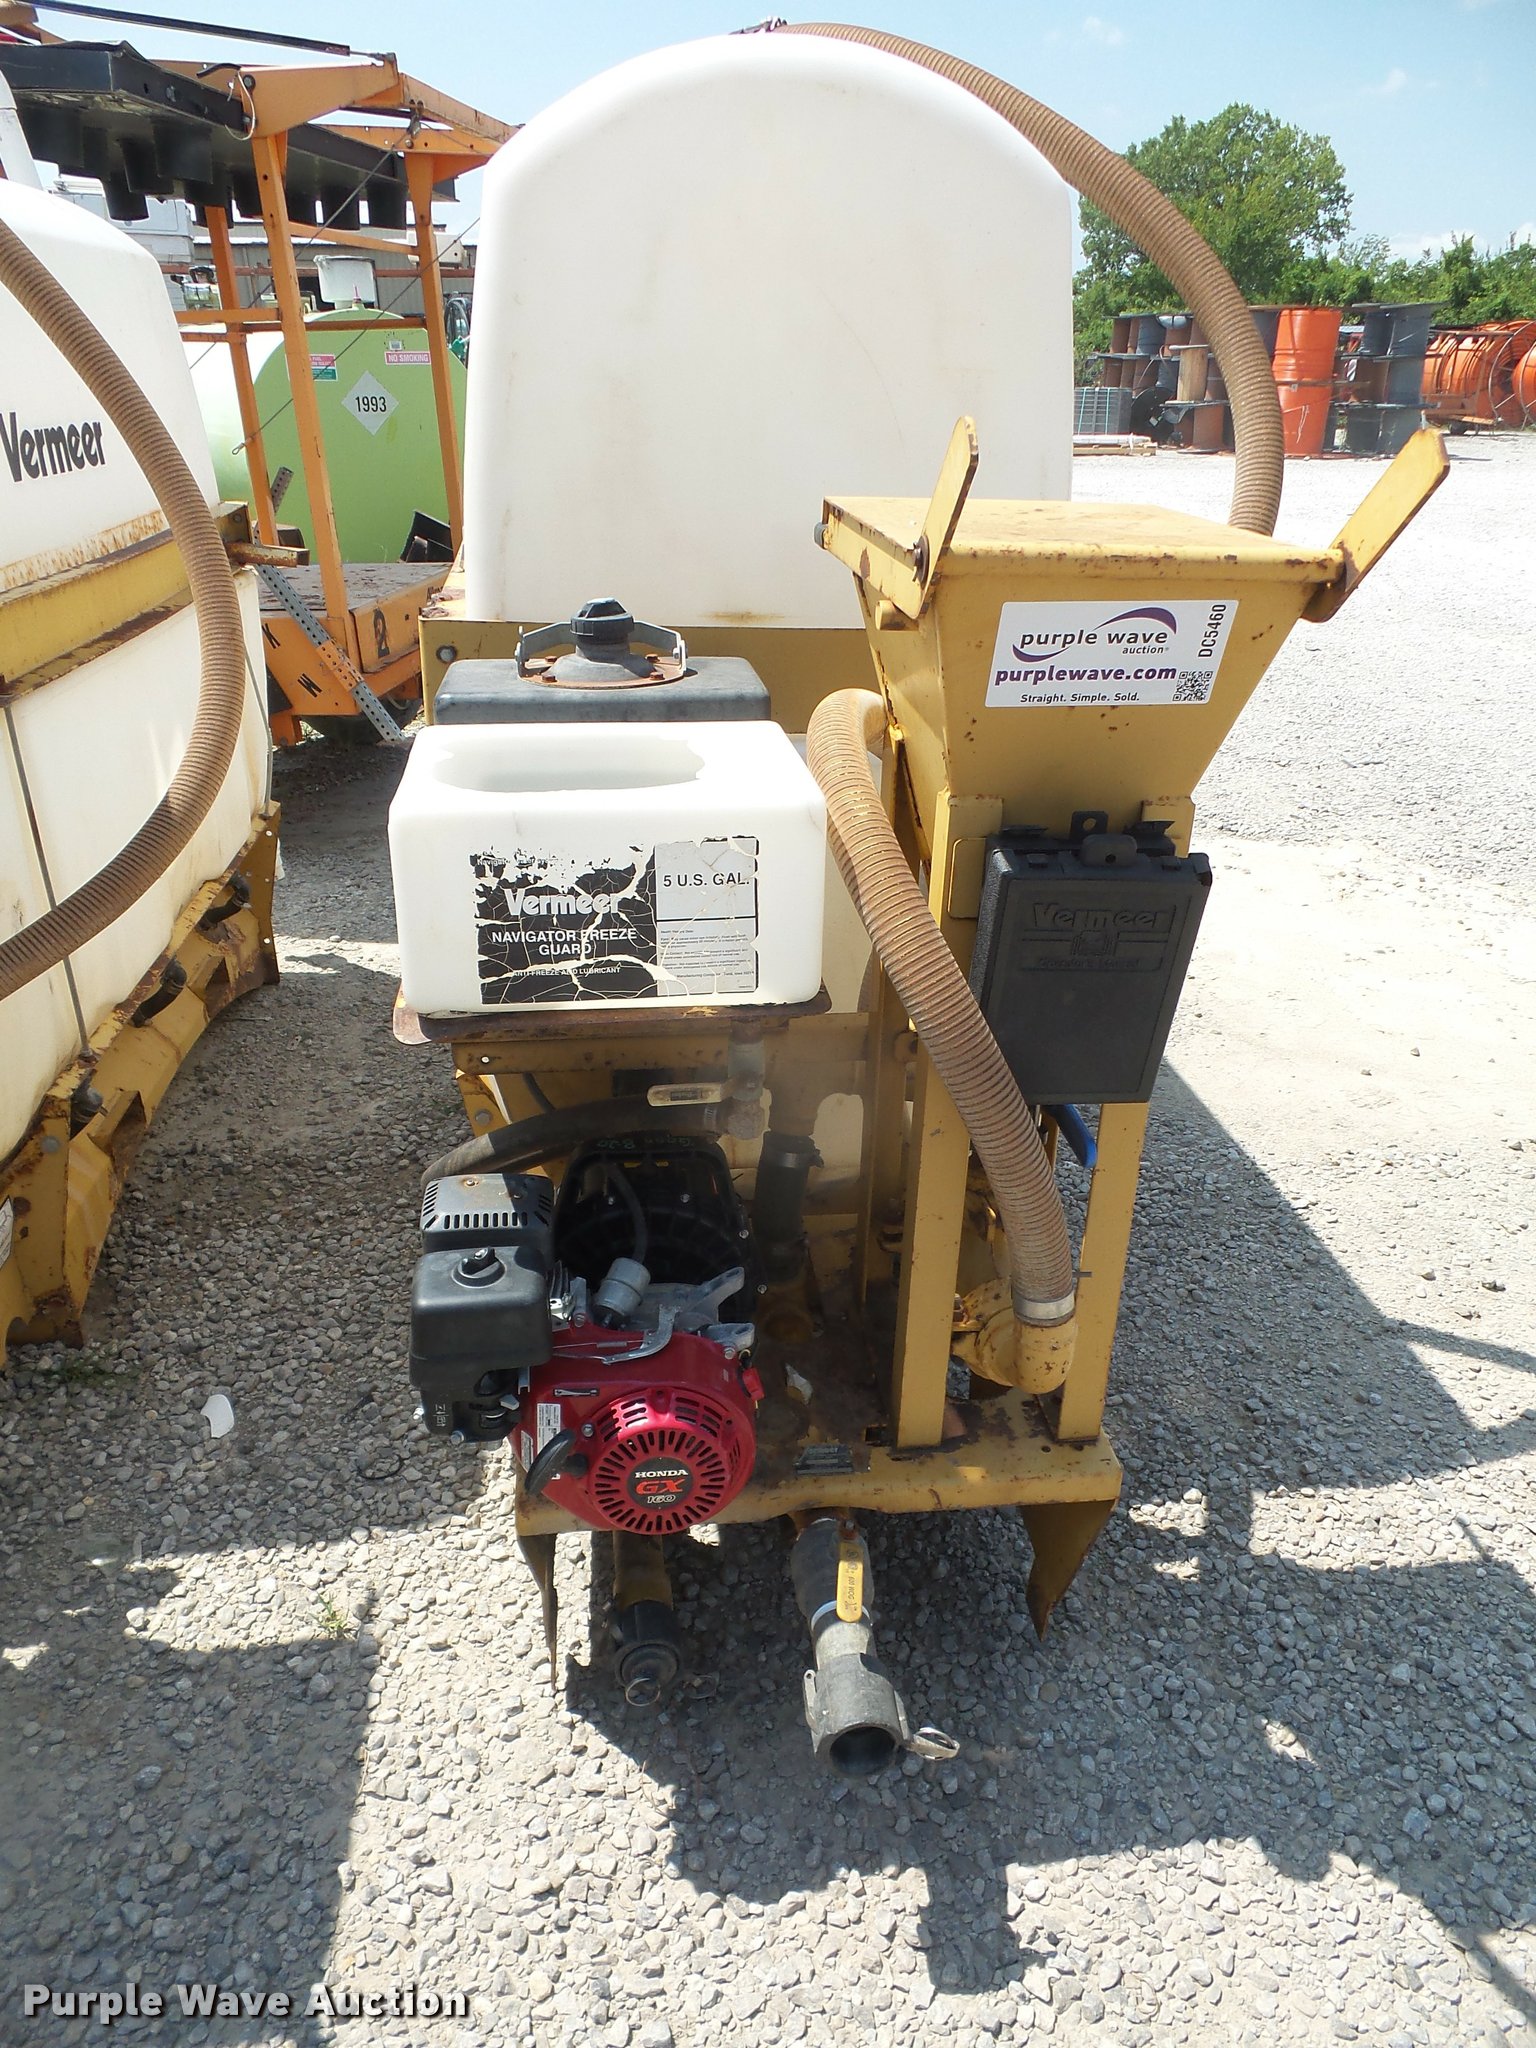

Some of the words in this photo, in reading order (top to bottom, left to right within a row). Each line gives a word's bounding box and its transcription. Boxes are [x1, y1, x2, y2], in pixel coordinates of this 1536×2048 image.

[388, 353, 398, 362] NO
[399, 353, 429, 362] SMOKING
[355, 396, 387, 413] 1993
[0, 411, 106, 483] Vermeer
[1020, 629, 1098, 648] purple
[1107, 631, 1168, 644] wave
[1198, 604, 1227, 658] DC5460
[995, 665, 1177, 686] purplewave.com
[1020, 693, 1067, 705] Straight.
[1071, 692, 1110, 704] Simple.
[1114, 692, 1140, 703] Sold.
[663, 875, 673, 889] 5
[677, 873, 708, 887] U.S.
[712, 872, 750, 886] GAL.
[503, 887, 621, 916] Vermeer
[1033, 903, 1173, 928] Vermeer
[492, 929, 580, 943] NAVIGATOR
[582, 928, 637, 941] FREEZE
[539, 942, 592, 956] GUARD
[512, 967, 561, 977] ANTI-FREEZE
[578, 966, 621, 976] LUBRICANT
[634, 1469, 689, 1478] HONDA
[635, 1478, 686, 1495] GX
[647, 1494, 676, 1504] 160
